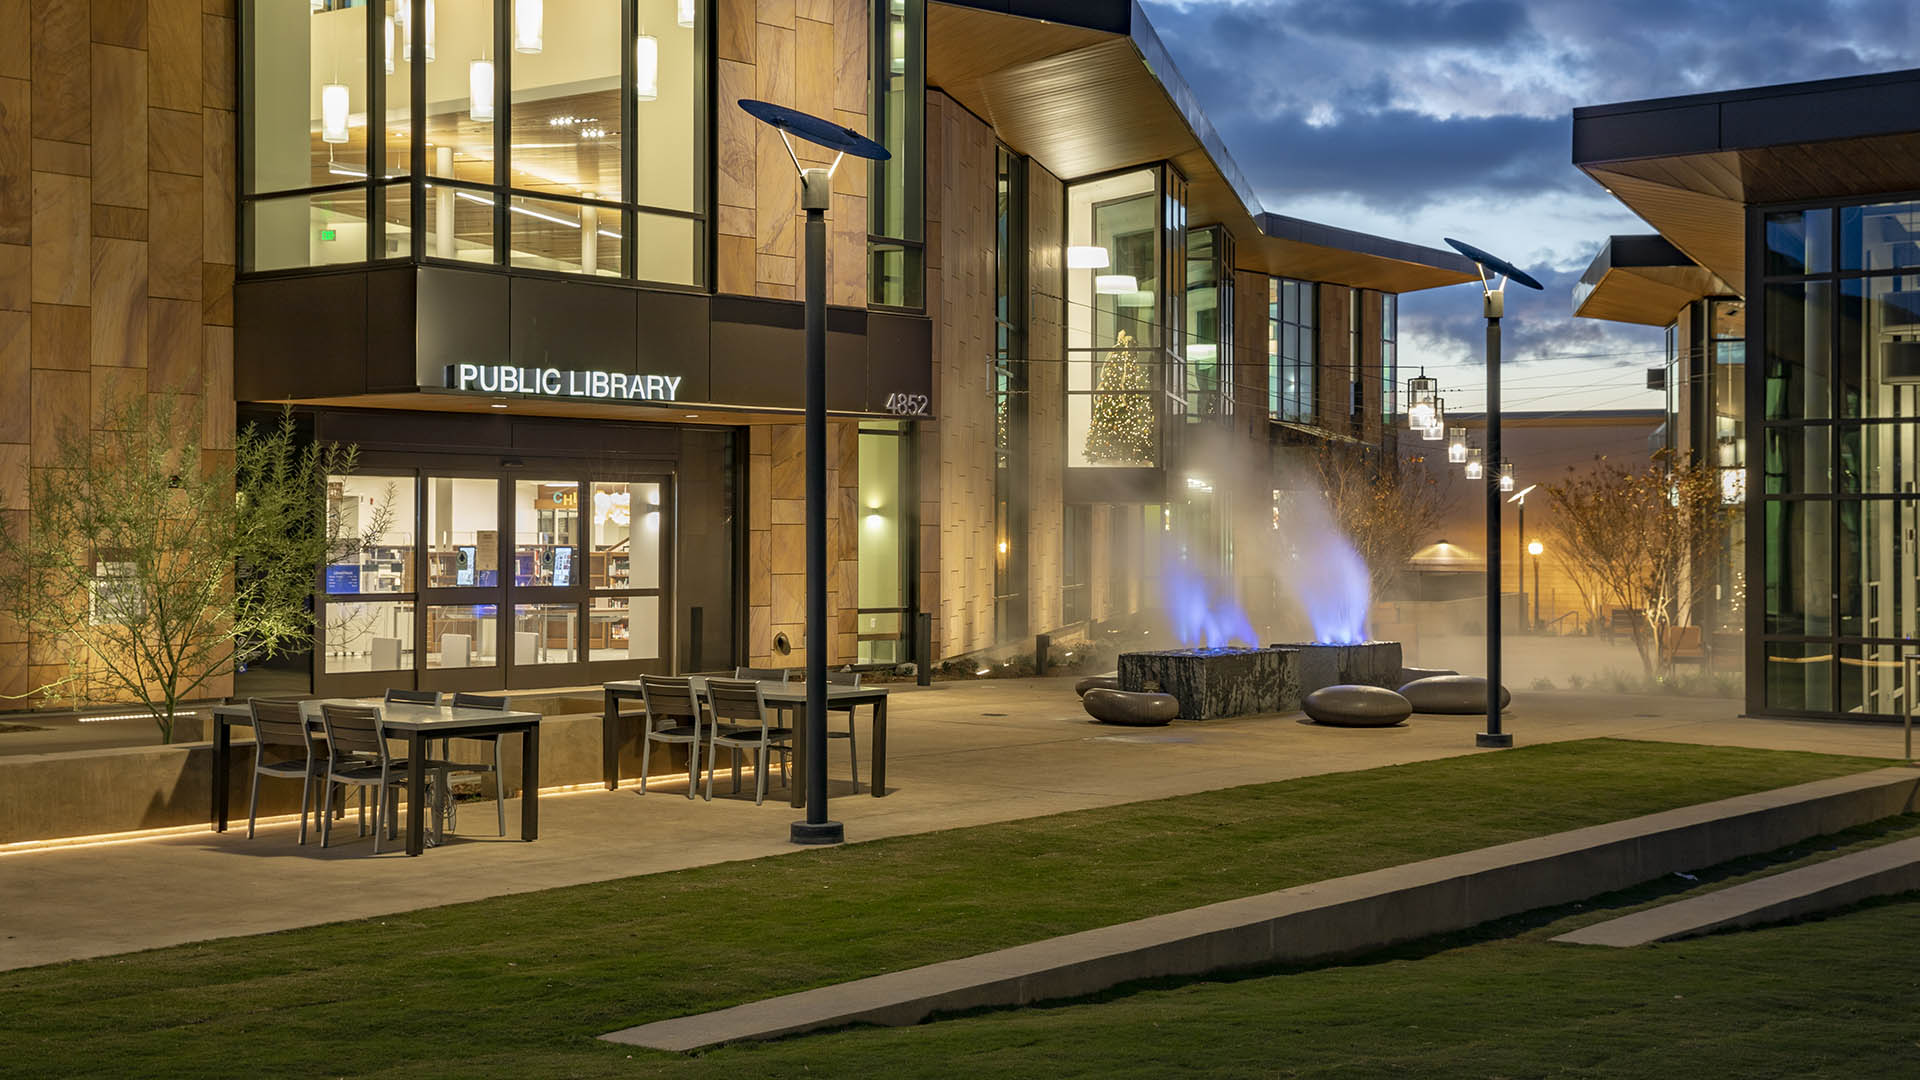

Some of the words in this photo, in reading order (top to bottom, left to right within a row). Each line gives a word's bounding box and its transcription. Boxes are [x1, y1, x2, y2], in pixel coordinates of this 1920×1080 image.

[460, 364, 561, 395] PUBLIC
[570, 370, 682, 400] LIBRARY
[886, 393, 928, 416] 4852
